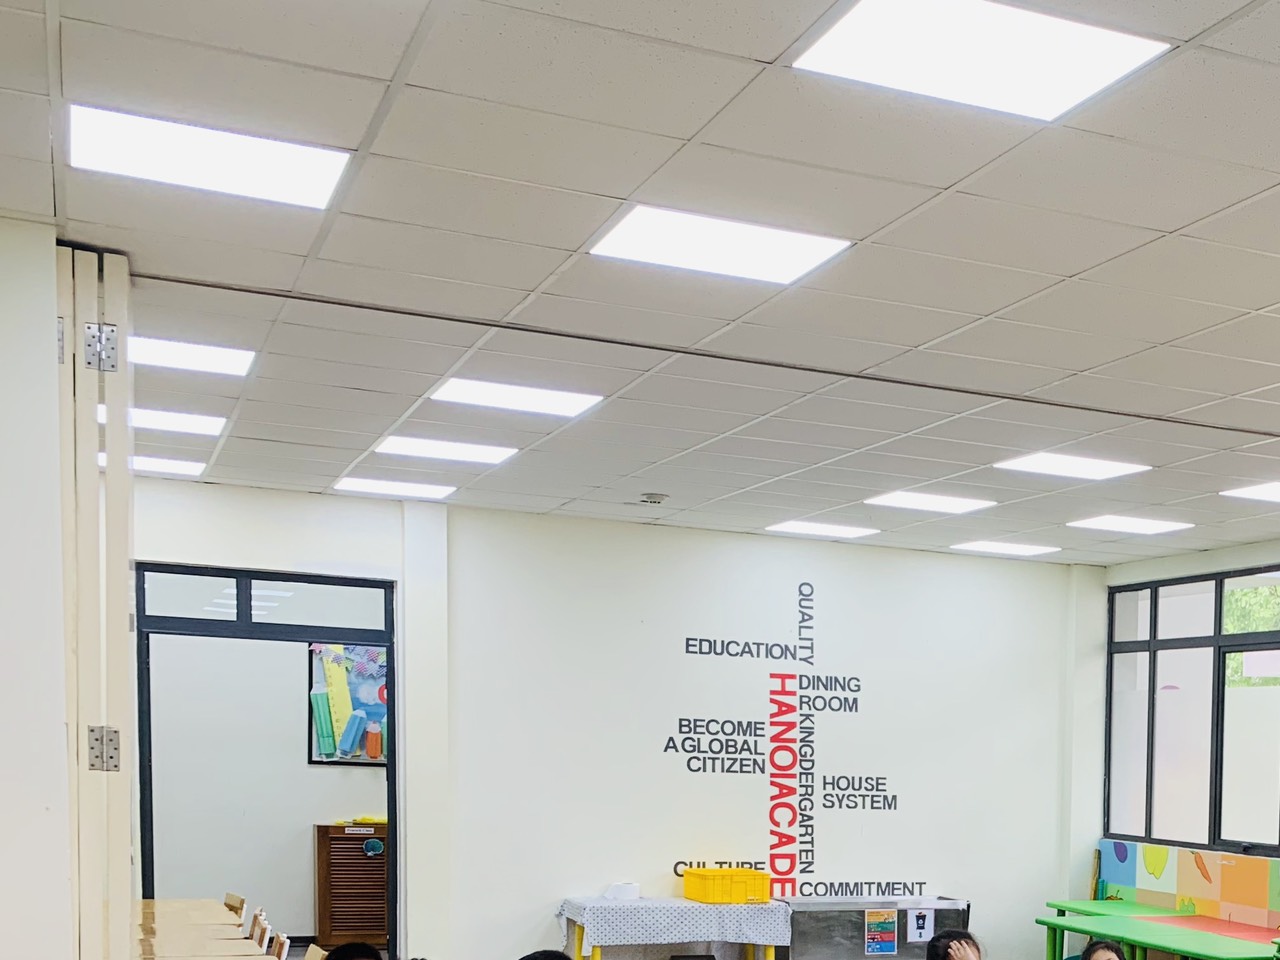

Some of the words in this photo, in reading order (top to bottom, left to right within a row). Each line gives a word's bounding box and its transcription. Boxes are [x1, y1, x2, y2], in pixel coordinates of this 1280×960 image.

[798, 582, 814, 666] QUALITY
[685, 637, 797, 661] EDUCATION
[799, 674, 861, 693] DINING
[799, 695, 858, 713] ROOM
[678, 718, 766, 738] BECOME
[687, 756, 766, 775] CITIZEN
[822, 775, 887, 792] HOUSE
[798, 714, 815, 874] KINGDERGARTEN
[822, 793, 898, 811] SYSTEM
[799, 881, 927, 897] COMMITMENT
